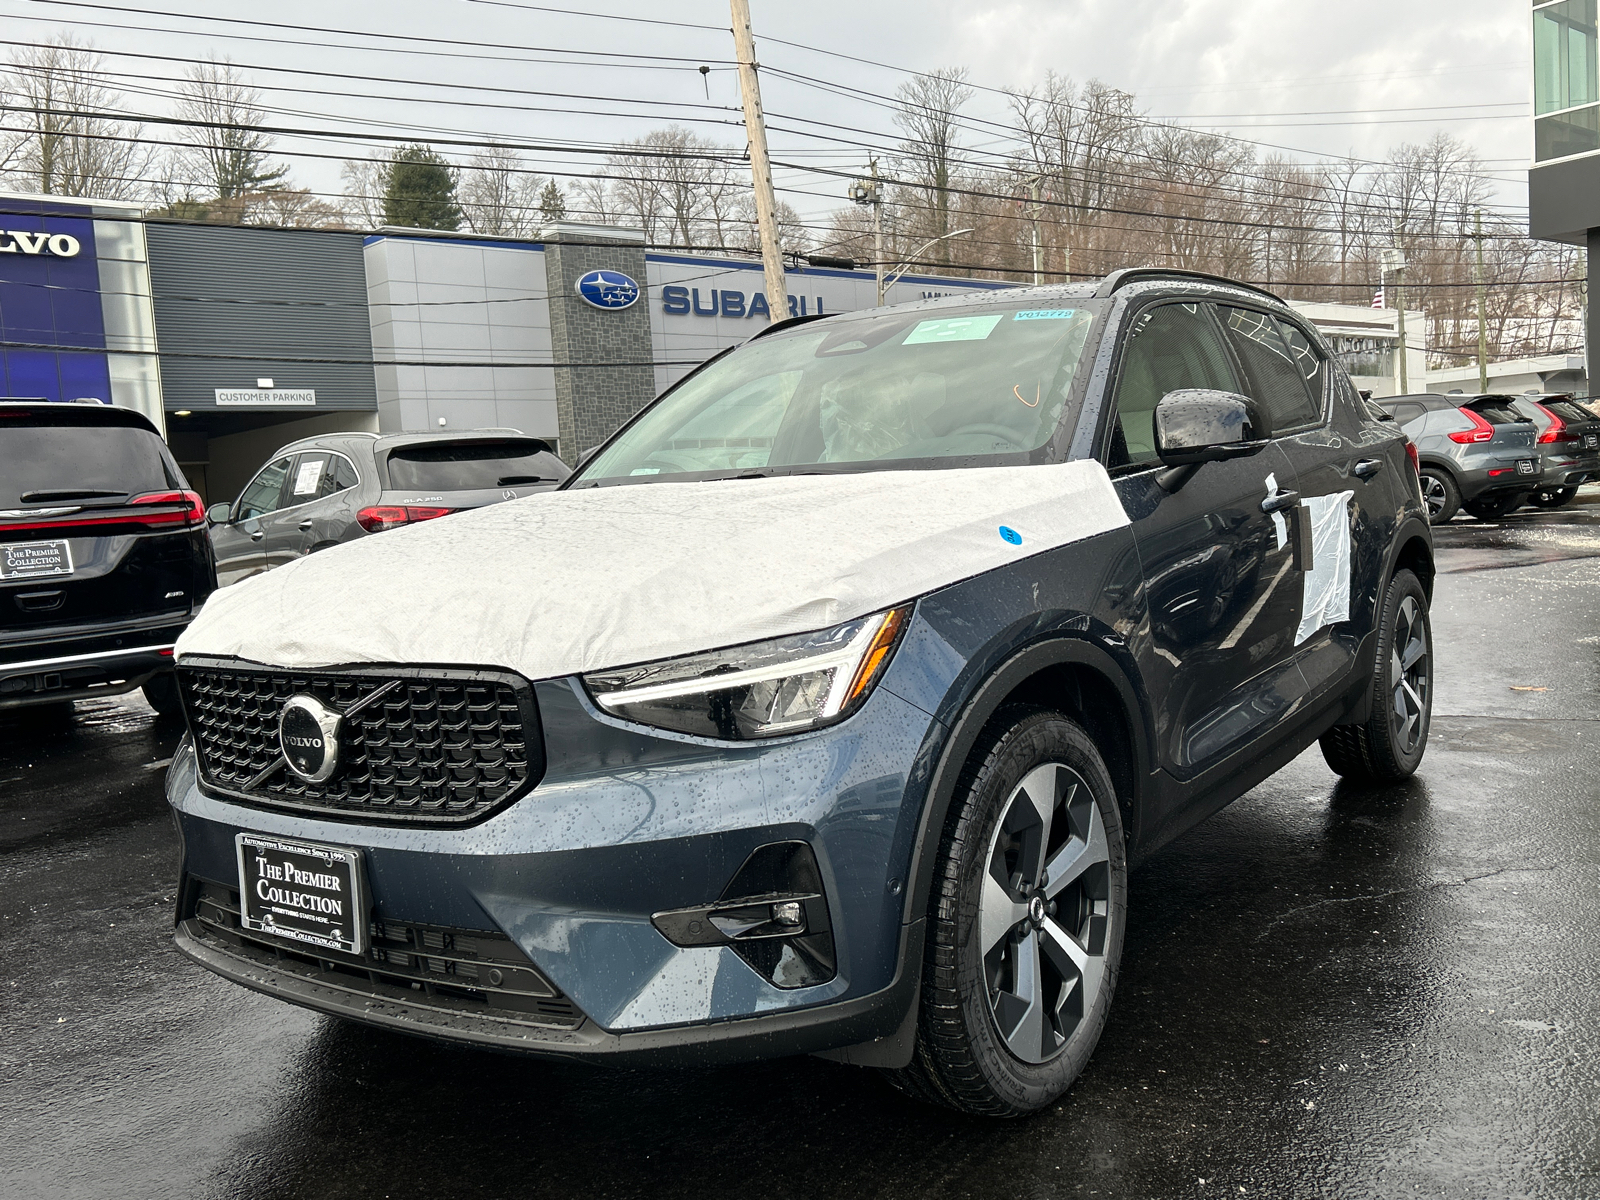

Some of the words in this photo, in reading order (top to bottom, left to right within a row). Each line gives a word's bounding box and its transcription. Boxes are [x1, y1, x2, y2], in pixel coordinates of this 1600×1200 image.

[219, 392, 270, 402] CUSTOMER
[273, 392, 313, 402] PARKING
[5, 550, 25, 559] THE
[25, 548, 60, 557] PREMIER
[7, 556, 61, 567] COLLECTION
[284, 735, 322, 748] VOLVO
[244, 837, 278, 850] AUTOMOTIVE
[277, 841, 311, 855] EXCELLENCE
[311, 847, 330, 859] SINCE
[330, 852, 346, 861] 1995
[256, 856, 283, 881] THE
[283, 861, 342, 892] PREMIER
[256, 879, 342, 916] COLLECTION
[260, 922, 342, 950] THEPREMIERCOLLECTION.COM
